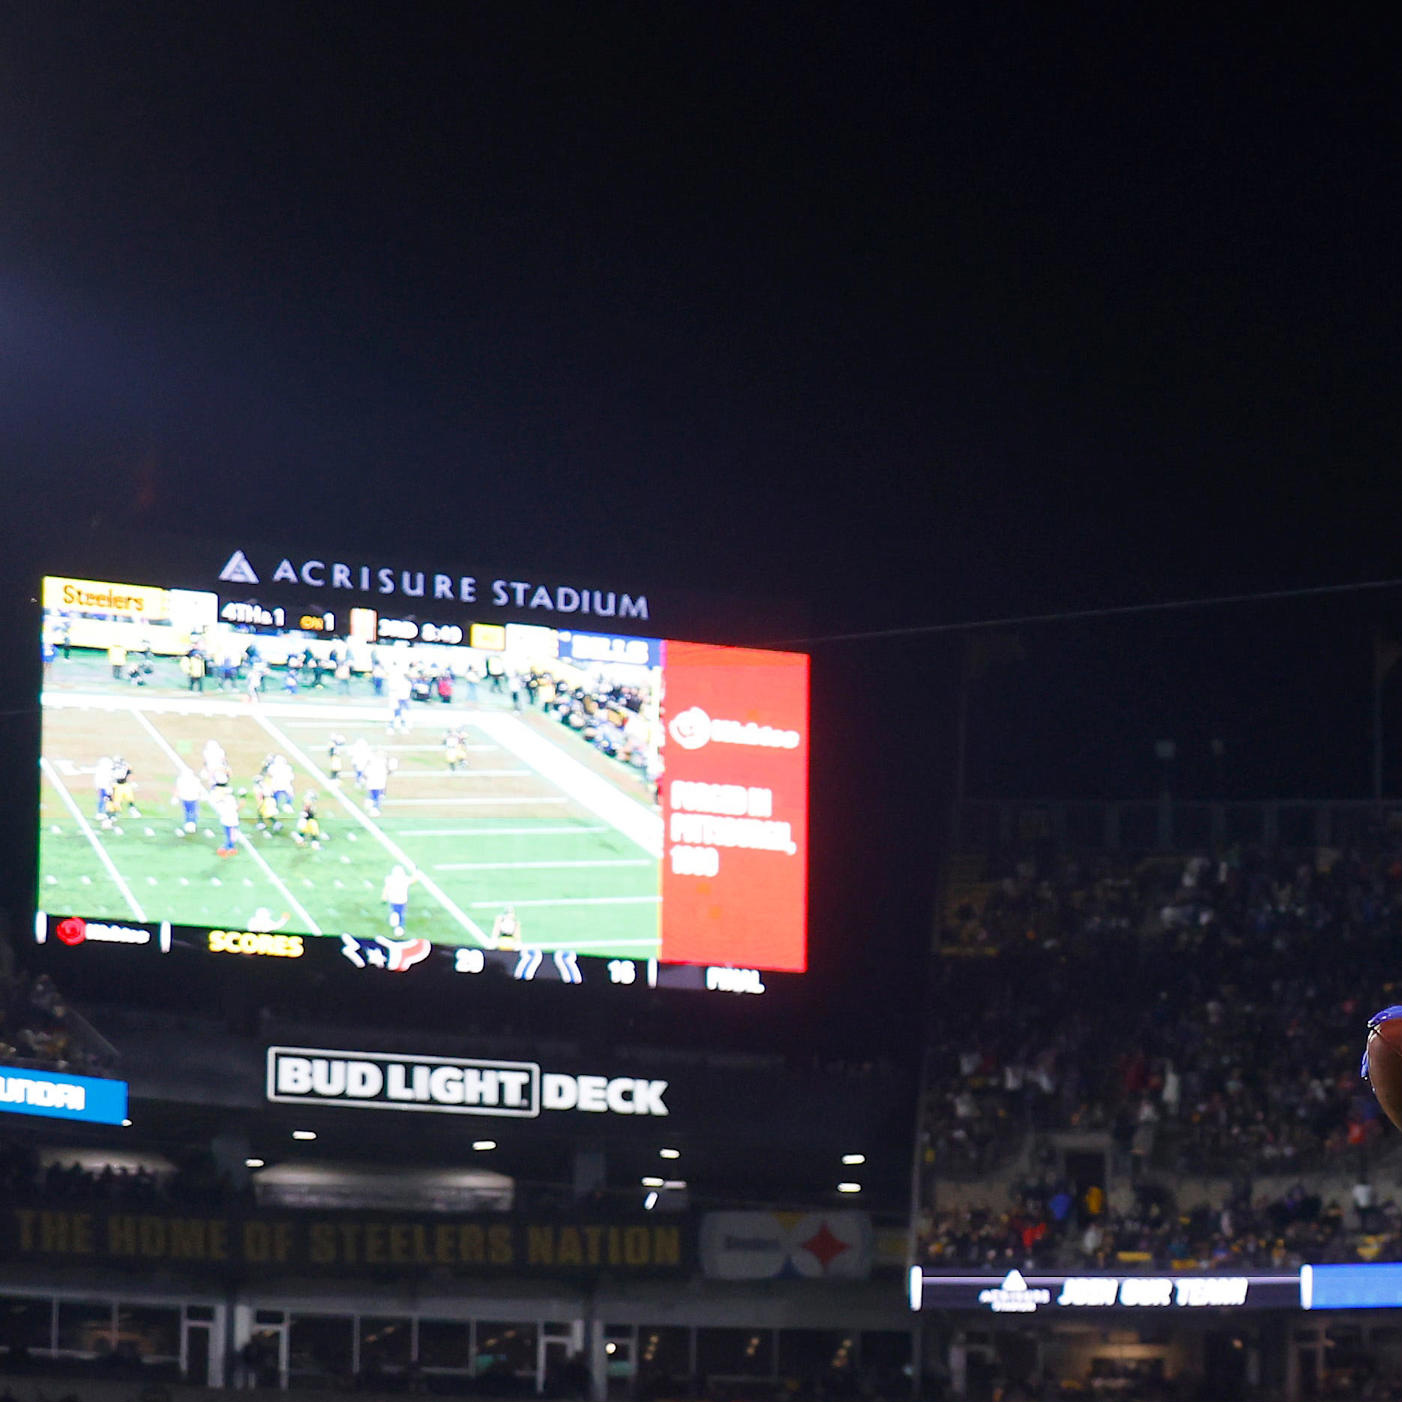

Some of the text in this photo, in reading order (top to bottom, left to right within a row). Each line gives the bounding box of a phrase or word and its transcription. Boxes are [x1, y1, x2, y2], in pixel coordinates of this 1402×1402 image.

[62, 584, 145, 612] Steelers
[272, 558, 650, 621] ACRISURE STADIUM
[208, 930, 304, 958] SCORES
[277, 1057, 669, 1116] BUD LIGHT DECK
[15, 1207, 681, 1265] THE HOME OF STEELERS NATION
